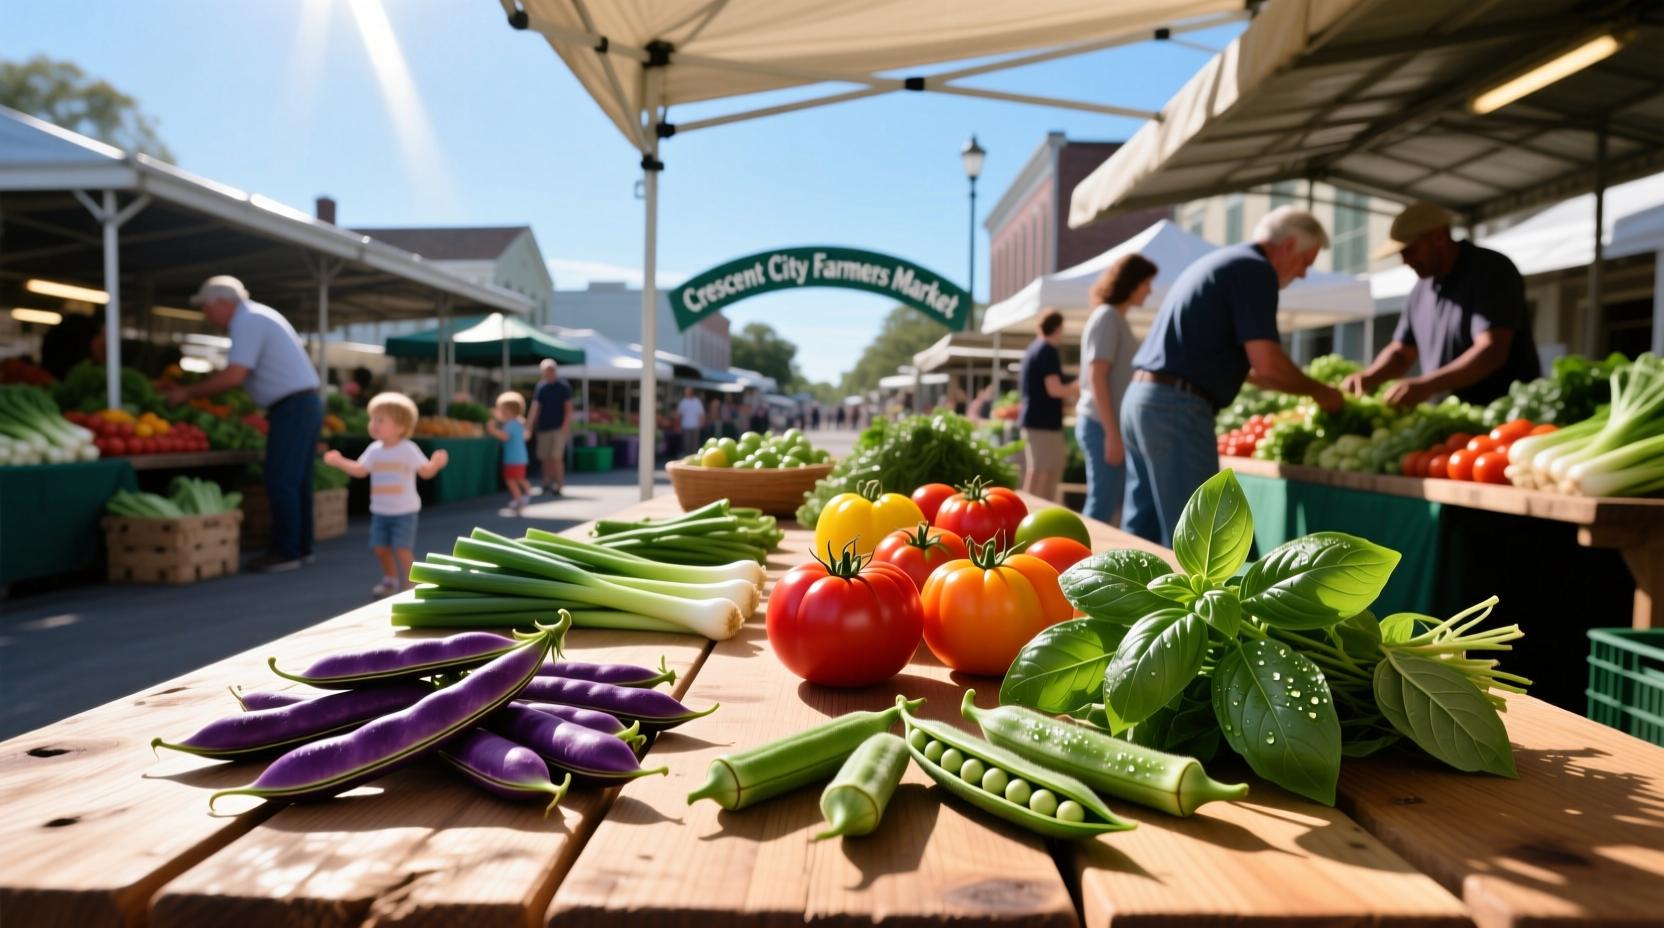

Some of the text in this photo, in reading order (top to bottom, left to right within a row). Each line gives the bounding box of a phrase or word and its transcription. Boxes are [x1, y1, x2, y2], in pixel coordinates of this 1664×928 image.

[683, 252, 959, 319] Crescent City Farmers Market
